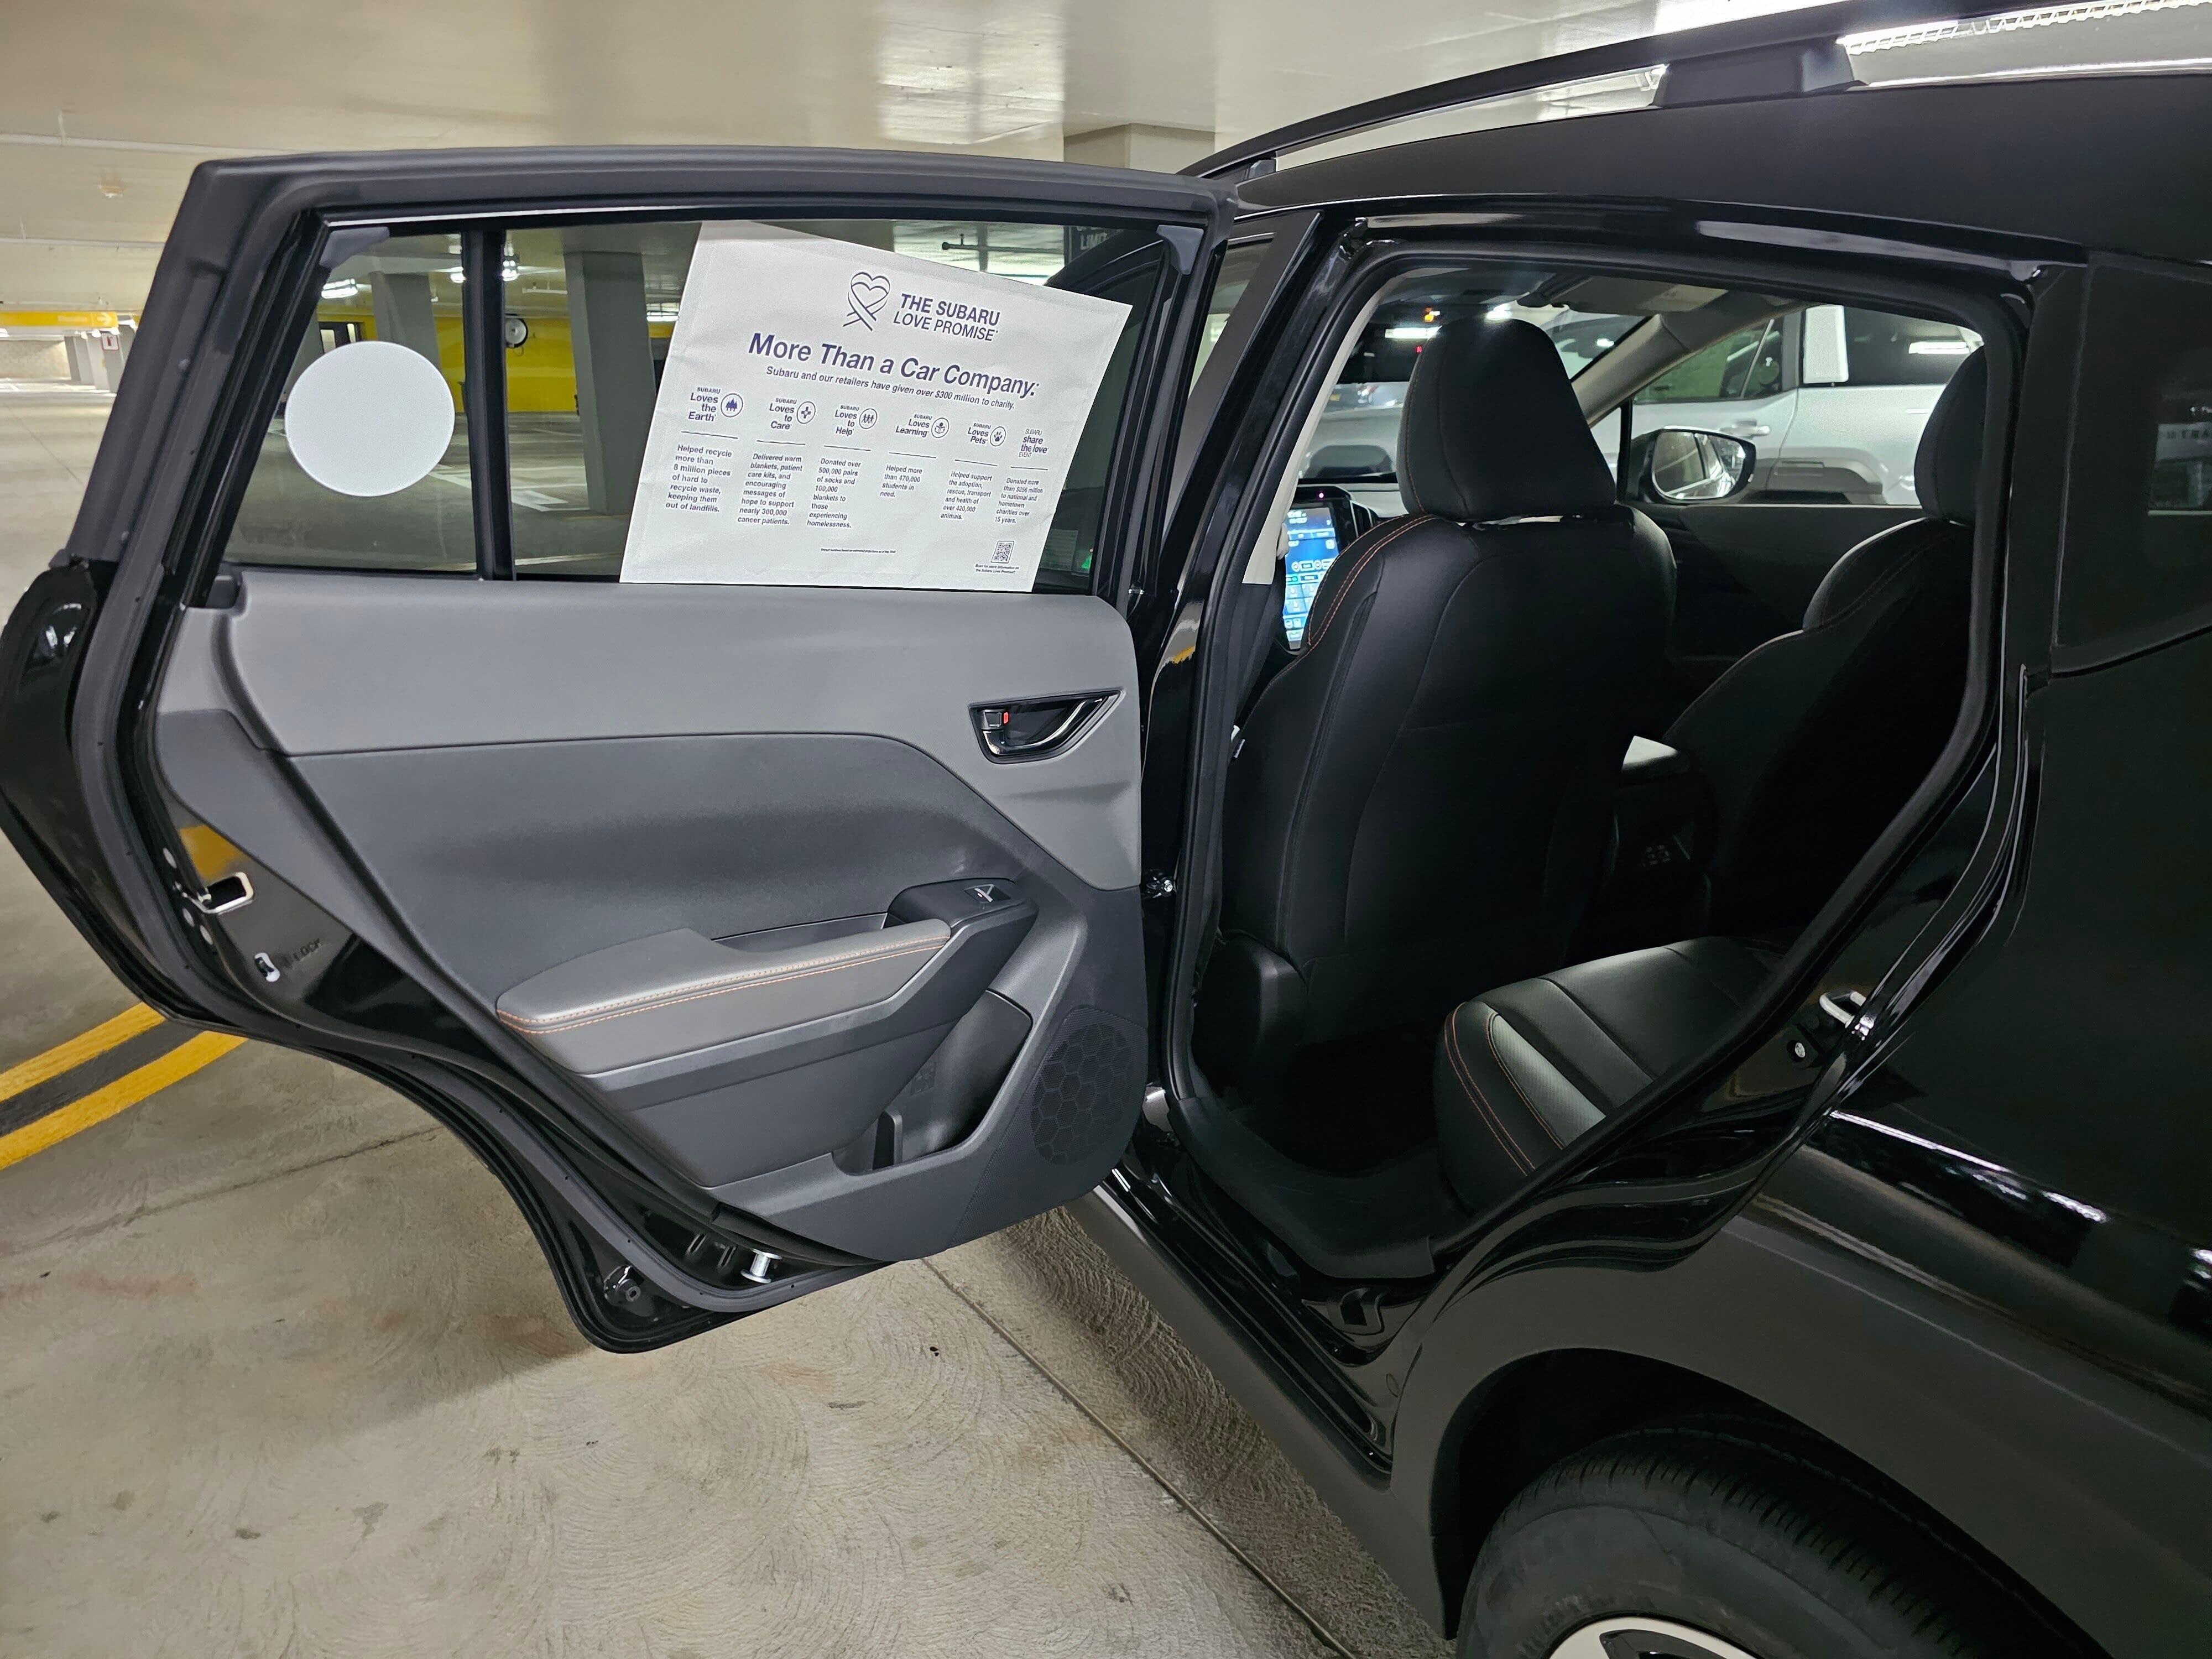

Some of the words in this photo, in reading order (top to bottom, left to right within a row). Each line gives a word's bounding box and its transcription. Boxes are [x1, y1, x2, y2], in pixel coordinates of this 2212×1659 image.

[901, 293, 933, 314] THE
[936, 301, 1000, 326] SUBARU
[893, 311, 932, 330] LOVE
[748, 333, 811, 362] More
[821, 343, 874, 371] Than
[880, 359, 894, 374] a
[901, 358, 940, 381] Car
[766, 366, 799, 378] Subaru
[801, 372, 817, 380] and
[835, 377, 869, 387] retailers
[870, 380, 890, 390] have
[891, 384, 914, 394] given
[935, 390, 953, 399] $300
[953, 393, 979, 404] million
[991, 399, 1014, 410] charity.
[690, 392, 718, 404] Loves
[702, 403, 716, 413] the
[769, 403, 795, 414] Loves
[688, 411, 714, 421] Earth
[834, 409, 857, 419] Loves
[770, 421, 790, 430] Care
[908, 419, 930, 428] Loves
[836, 426, 853, 437] Help
[895, 426, 927, 437] Learning
[967, 427, 989, 437] Loves
[970, 436, 988, 444] Pets
[1022, 435, 1044, 445] share
[677, 444, 704, 454] Helped
[706, 449, 732, 457] recycle
[1021, 444, 1032, 452] the
[1032, 444, 1047, 453] love
[697, 456, 713, 465] than
[753, 453, 784, 461] Delivered
[750, 462, 779, 471] blankets,
[821, 458, 847, 466] Donated
[680, 465, 706, 474] million
[707, 468, 731, 476] pieces
[818, 467, 842, 476] 500,000
[886, 465, 907, 473] Helped
[682, 474, 699, 483] hard
[763, 471, 776, 480] kits,
[951, 471, 970, 479] Helped
[670, 484, 697, 493] recycle
[745, 481, 786, 490] encouraging
[816, 485, 838, 493] 100,000
[958, 481, 983, 489] adoption,
[667, 492, 698, 503] keeping
[967, 489, 991, 498] transport
[741, 498, 758, 506] hope
[690, 503, 719, 512] landfills.
[761, 508, 787, 517] 300,000
[809, 512, 847, 520] experiencing
[807, 520, 852, 528] homelessness.
